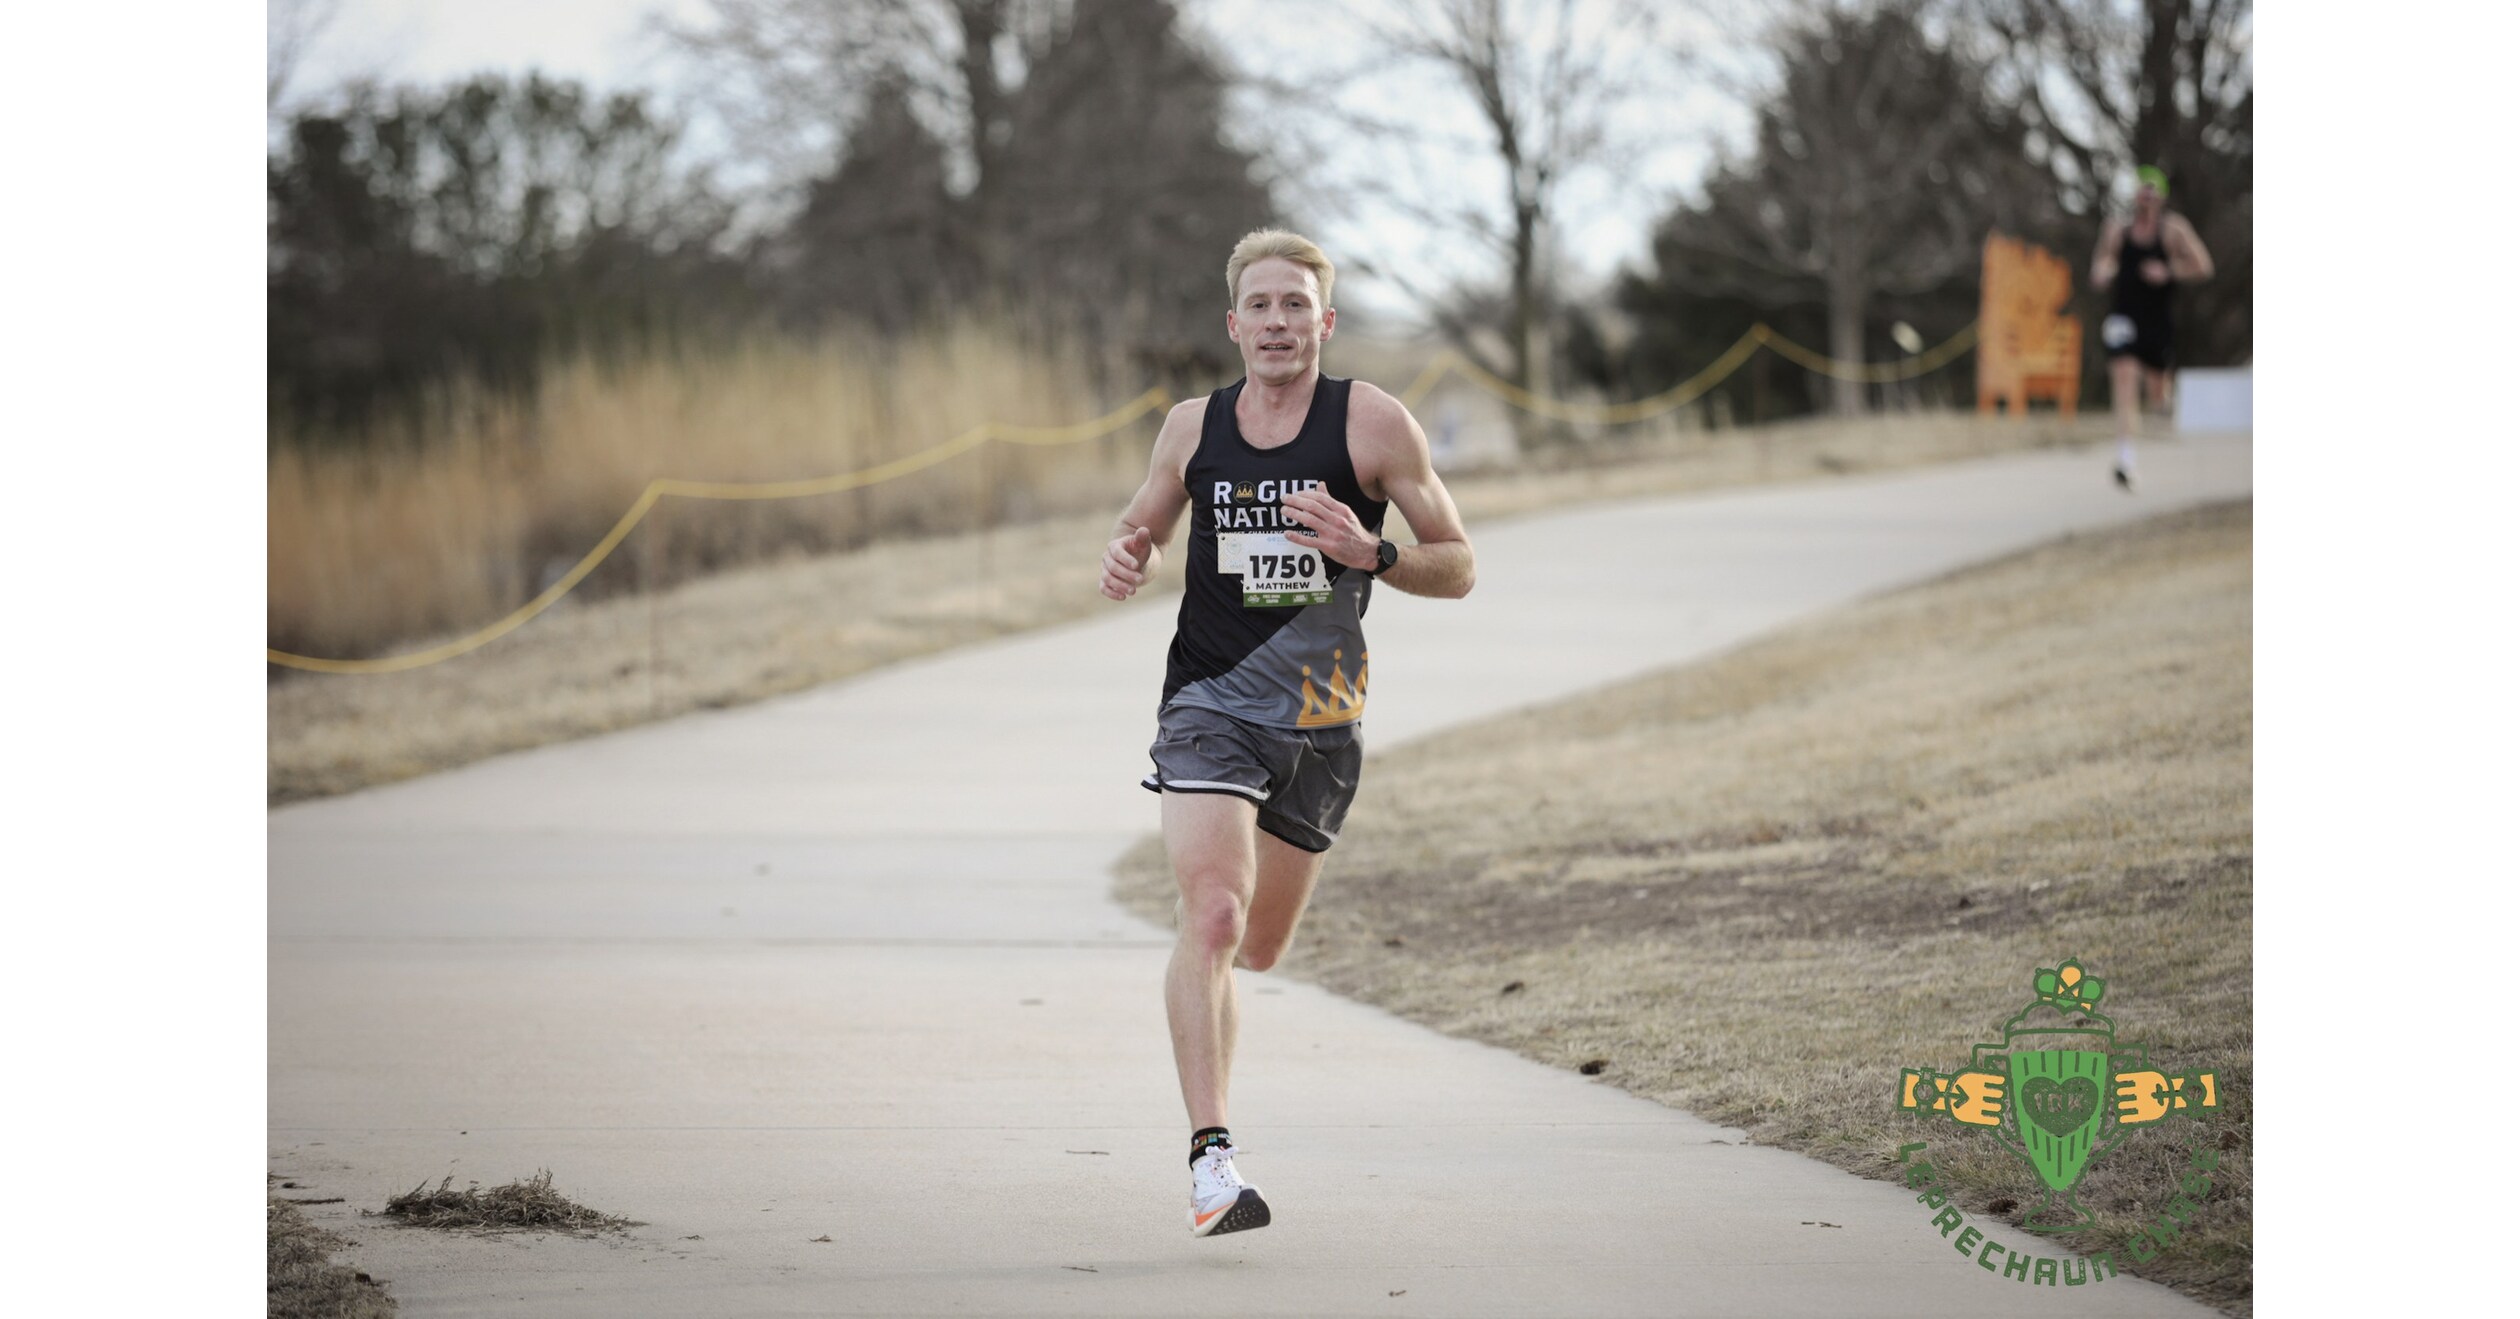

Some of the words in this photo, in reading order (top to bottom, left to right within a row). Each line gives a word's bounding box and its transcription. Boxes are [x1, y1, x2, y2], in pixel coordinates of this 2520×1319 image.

[1213, 507, 1311, 528] NATI
[1250, 554, 1316, 579] 1750
[1255, 581, 1310, 590] MATTHEW
